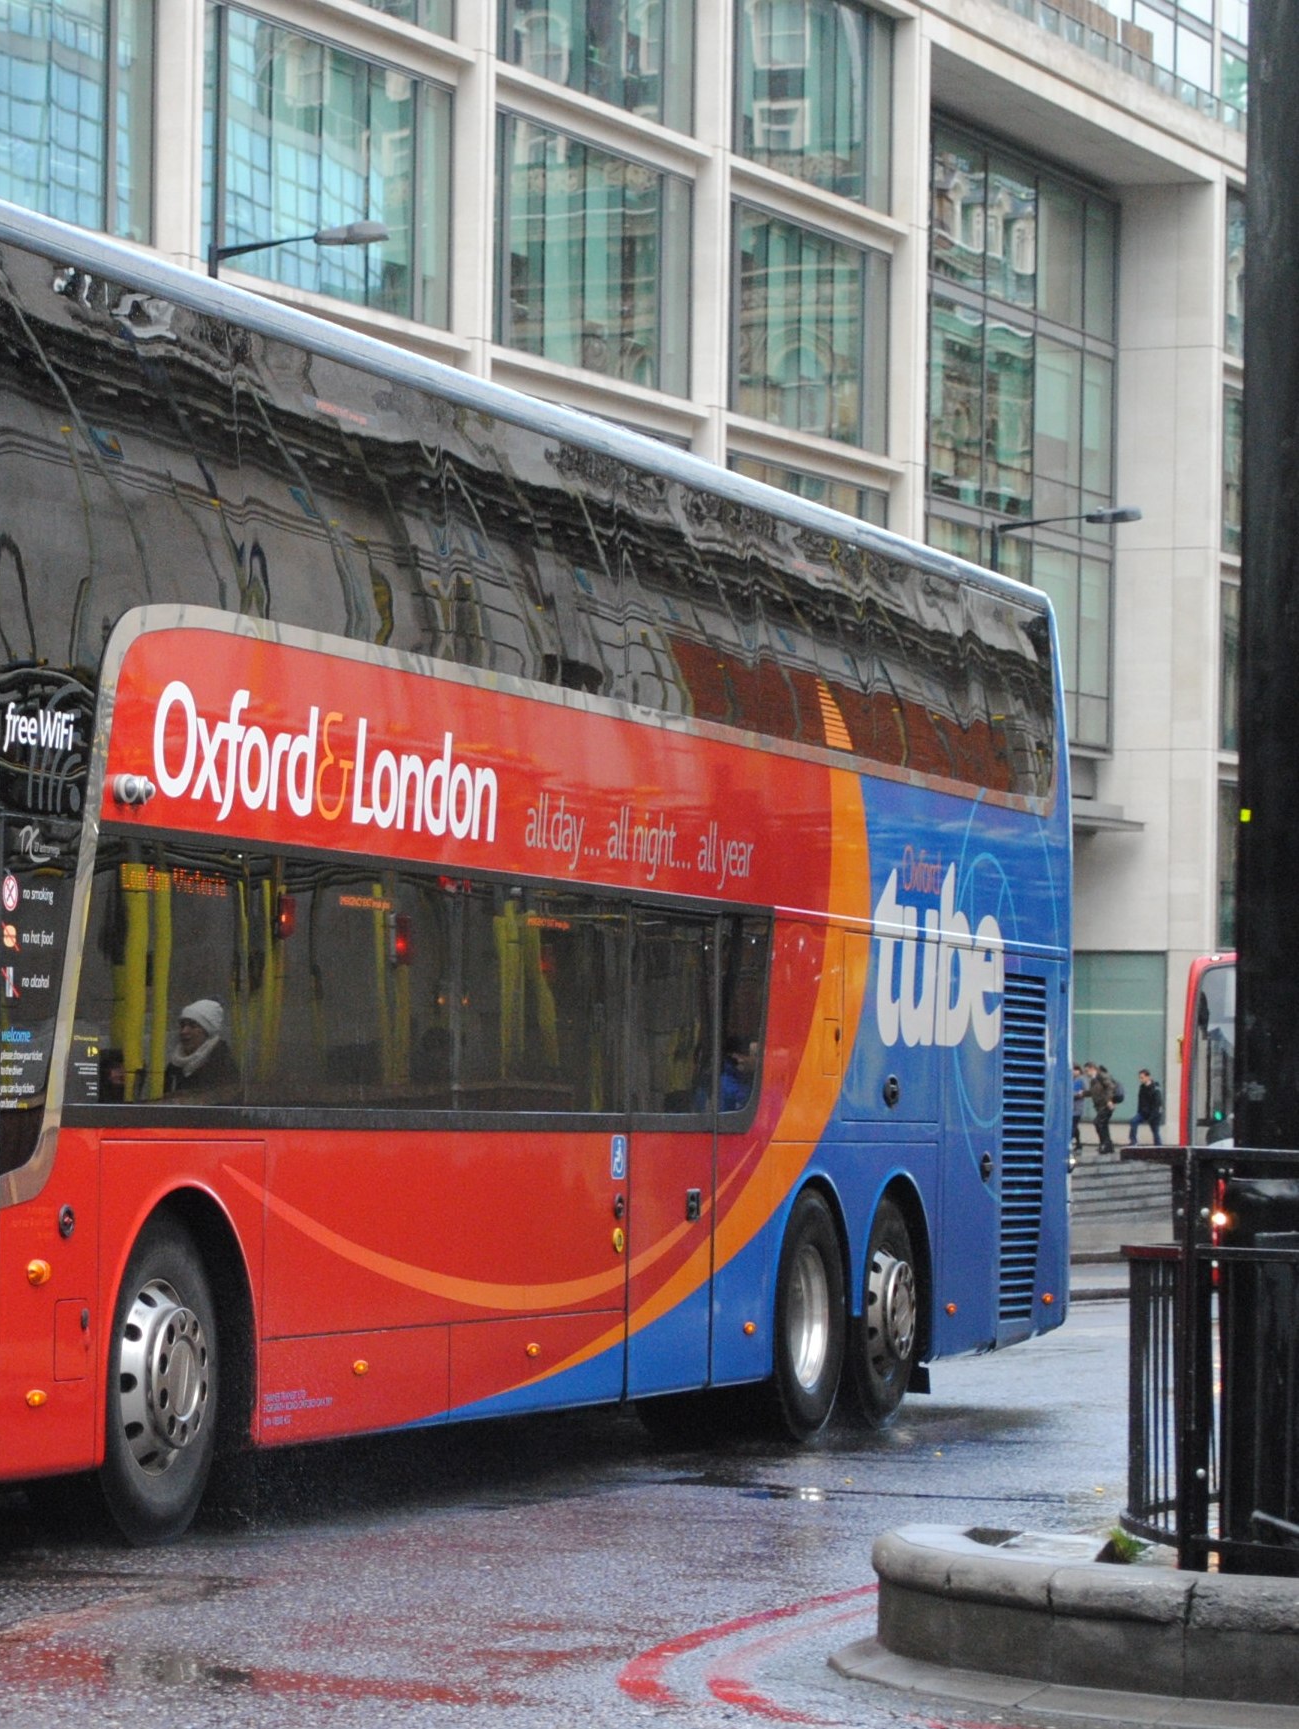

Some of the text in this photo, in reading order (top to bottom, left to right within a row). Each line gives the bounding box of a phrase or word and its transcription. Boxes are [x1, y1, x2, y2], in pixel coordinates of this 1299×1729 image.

[3, 702, 75, 752] free WiFi
[154, 680, 498, 842] Oxford & London
[524, 792, 549, 850] all
[607, 806, 629, 861] all
[697, 820, 717, 873] all
[717, 838, 755, 890] year
[902, 845, 943, 895] Oxford
[22, 888, 54, 905] no smoking
[22, 930, 54, 947] no hot food
[874, 861, 1004, 1051] tube
[21, 974, 50, 989] no alcohol
[1, 1026, 31, 1042] welcome
